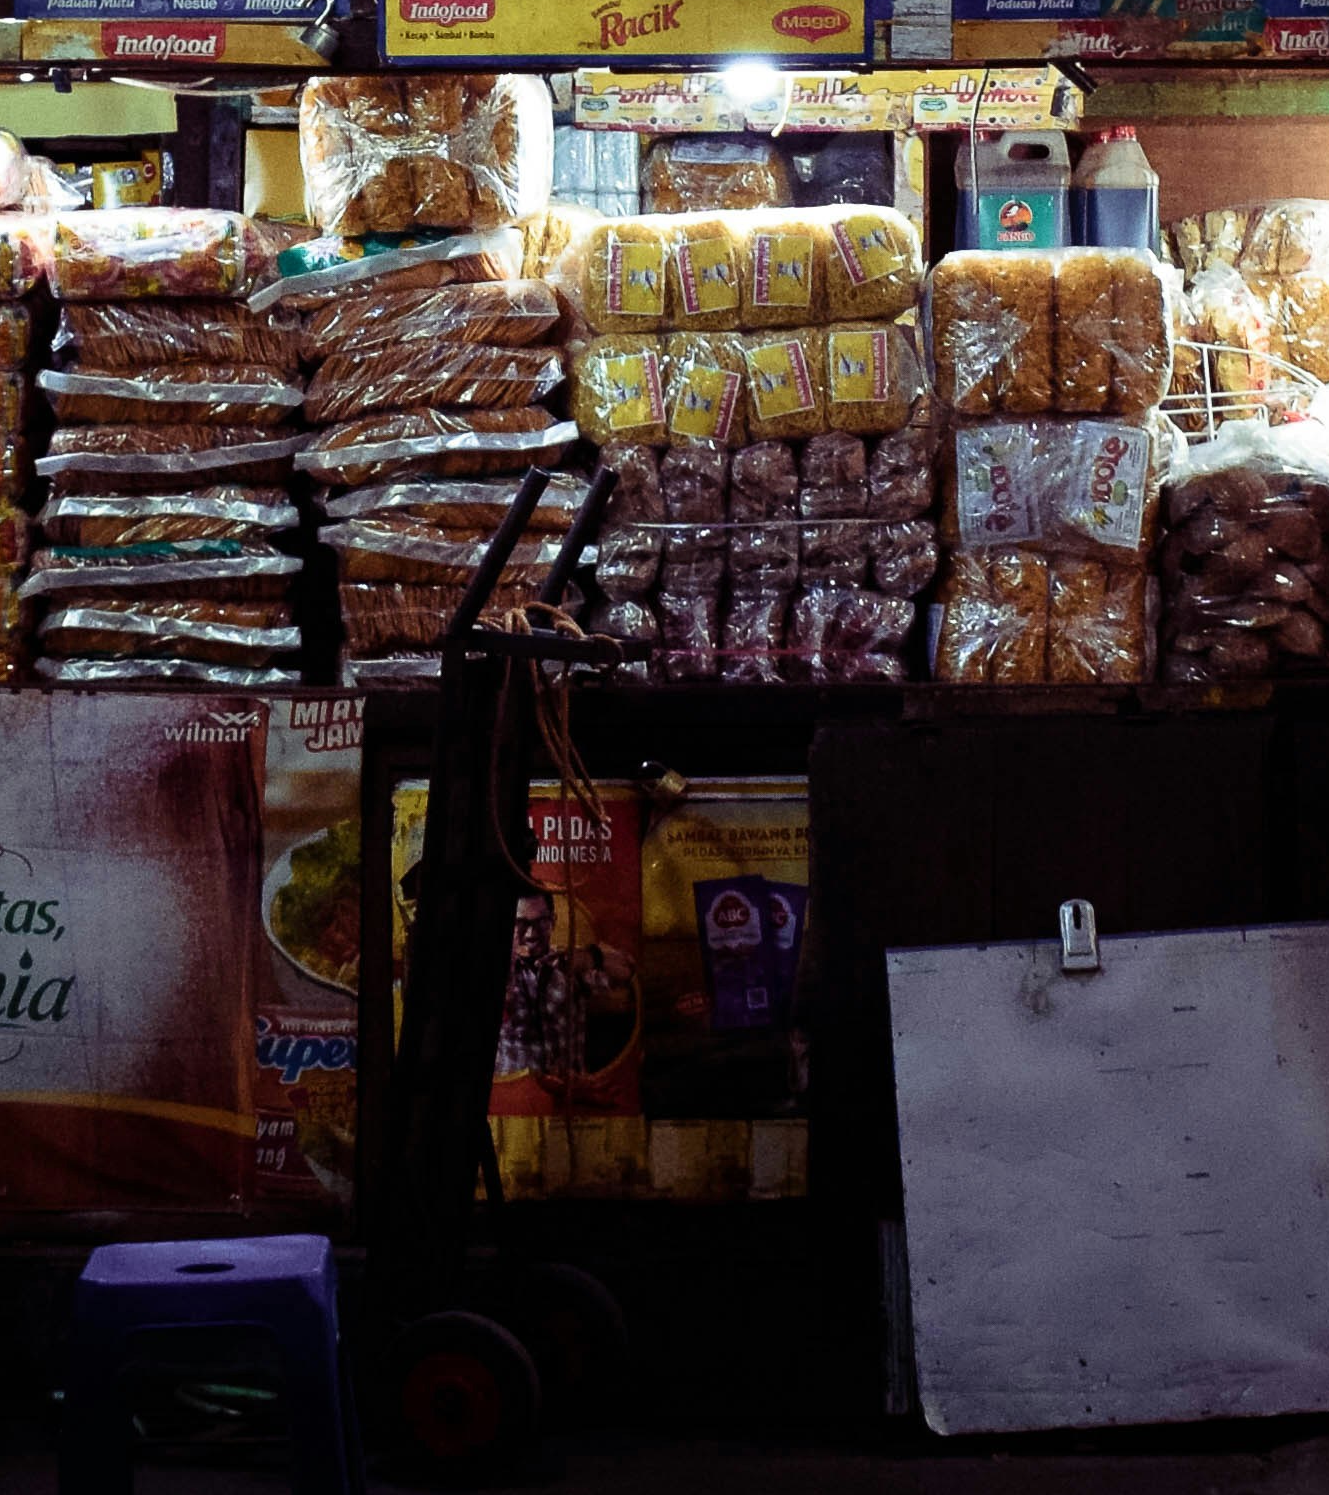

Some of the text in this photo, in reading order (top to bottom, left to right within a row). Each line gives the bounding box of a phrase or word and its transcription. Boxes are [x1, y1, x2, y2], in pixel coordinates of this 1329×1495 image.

[409, 1, 488, 24] Indofood
[781, 15, 842, 33] Maggi
[114, 34, 217, 60] Indofood
[164, 724, 251, 743] wilmar
[536, 845, 613, 865] INDONESA
